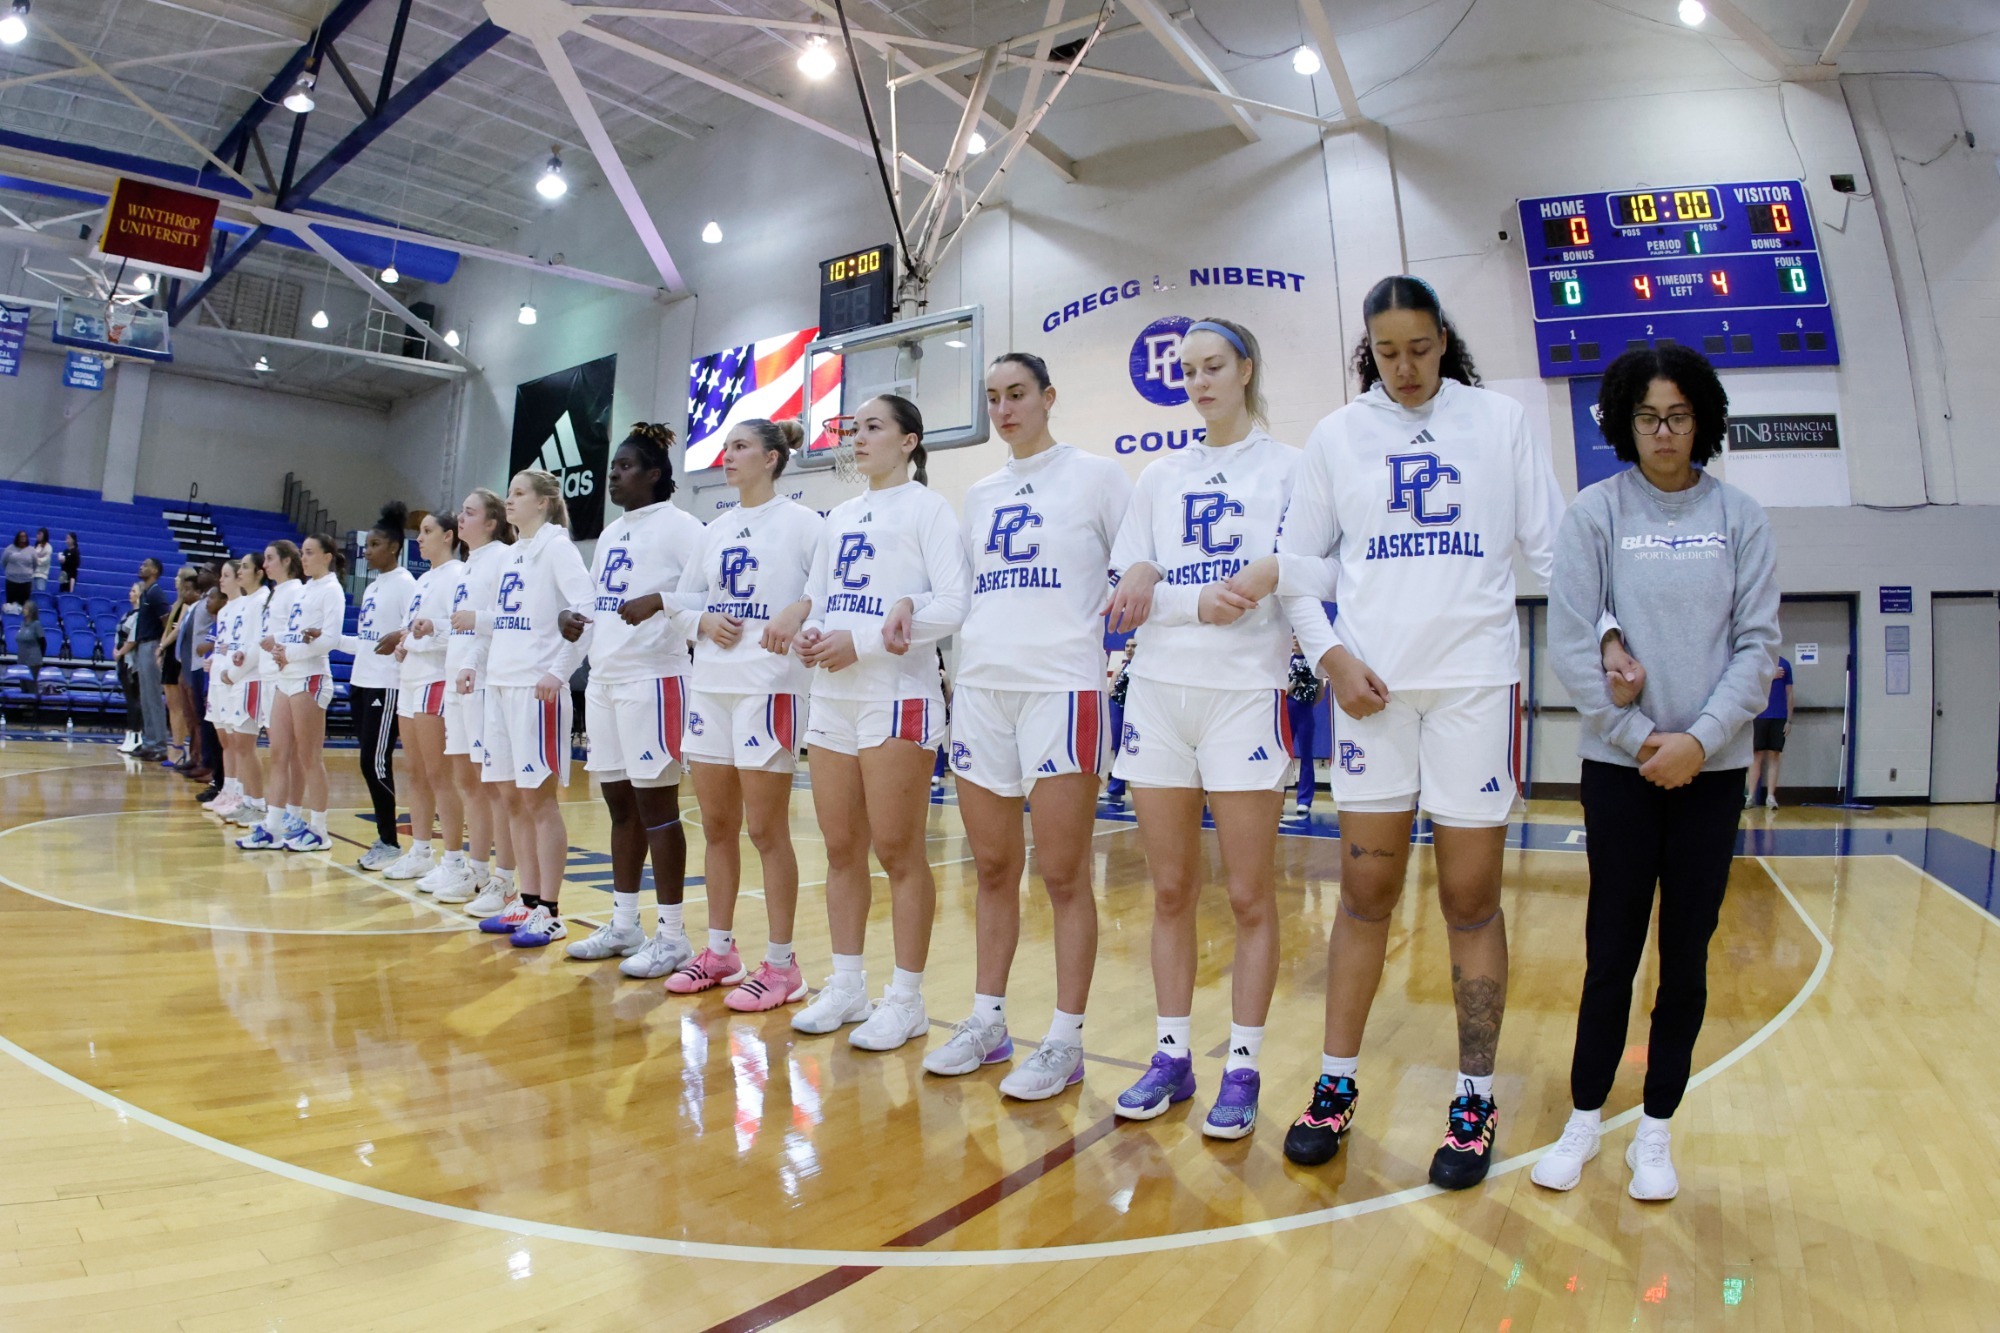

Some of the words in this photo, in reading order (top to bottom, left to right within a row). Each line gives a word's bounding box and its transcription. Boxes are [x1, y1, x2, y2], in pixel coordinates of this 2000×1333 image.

[1733, 186, 1792, 203] VISITOR
[128, 203, 200, 230] WINTHROP
[1540, 200, 1586, 218] HOME
[1631, 190, 1712, 222] 10:00
[1699, 223, 1718, 232] POSS
[1771, 204, 1792, 232] 0
[120, 218, 200, 247] UNIVERSITY
[1570, 218, 1589, 244] 0
[1622, 228, 1641, 237] POSS
[1647, 239, 1681, 251] PERIOD
[1692, 231, 1701, 254] 1
[1751, 238, 1782, 249] BONUS
[830, 251, 880, 281] 10:00
[1562, 250, 1595, 261] BONUS
[1774, 256, 1802, 267] FOULS
[1549, 269, 1578, 281] FOULS
[1656, 273, 1704, 286] TIMEOUTS
[1711, 271, 1728, 294] 4
[1790, 268, 1807, 292] 0
[1564, 281, 1581, 305] 0
[1634, 276, 1651, 299] 4
[1670, 285, 1693, 297] LEFT
[1043, 279, 1141, 333] GREGG
[1189, 267, 1305, 293] NIBERT
[1646, 325, 1654, 335] 2
[1722, 321, 1729, 331] 3
[1795, 318, 1803, 328] 4
[1569, 330, 1576, 340] 1
[1730, 423, 1772, 443] TNB
[1773, 421, 1833, 432] FINANCIAL
[1774, 431, 1824, 442] SERVICES
[791, 491, 803, 500] of
[1385, 451, 1461, 527] PC
[985, 503, 1044, 565] PC
[1182, 490, 1245, 557] PC
[1365, 531, 1484, 560] BASKETBALL
[1634, 551, 1670, 561] SPORTS
[834, 531, 876, 590] PC
[718, 546, 759, 600] PC
[1338, 740, 1366, 775] PC
